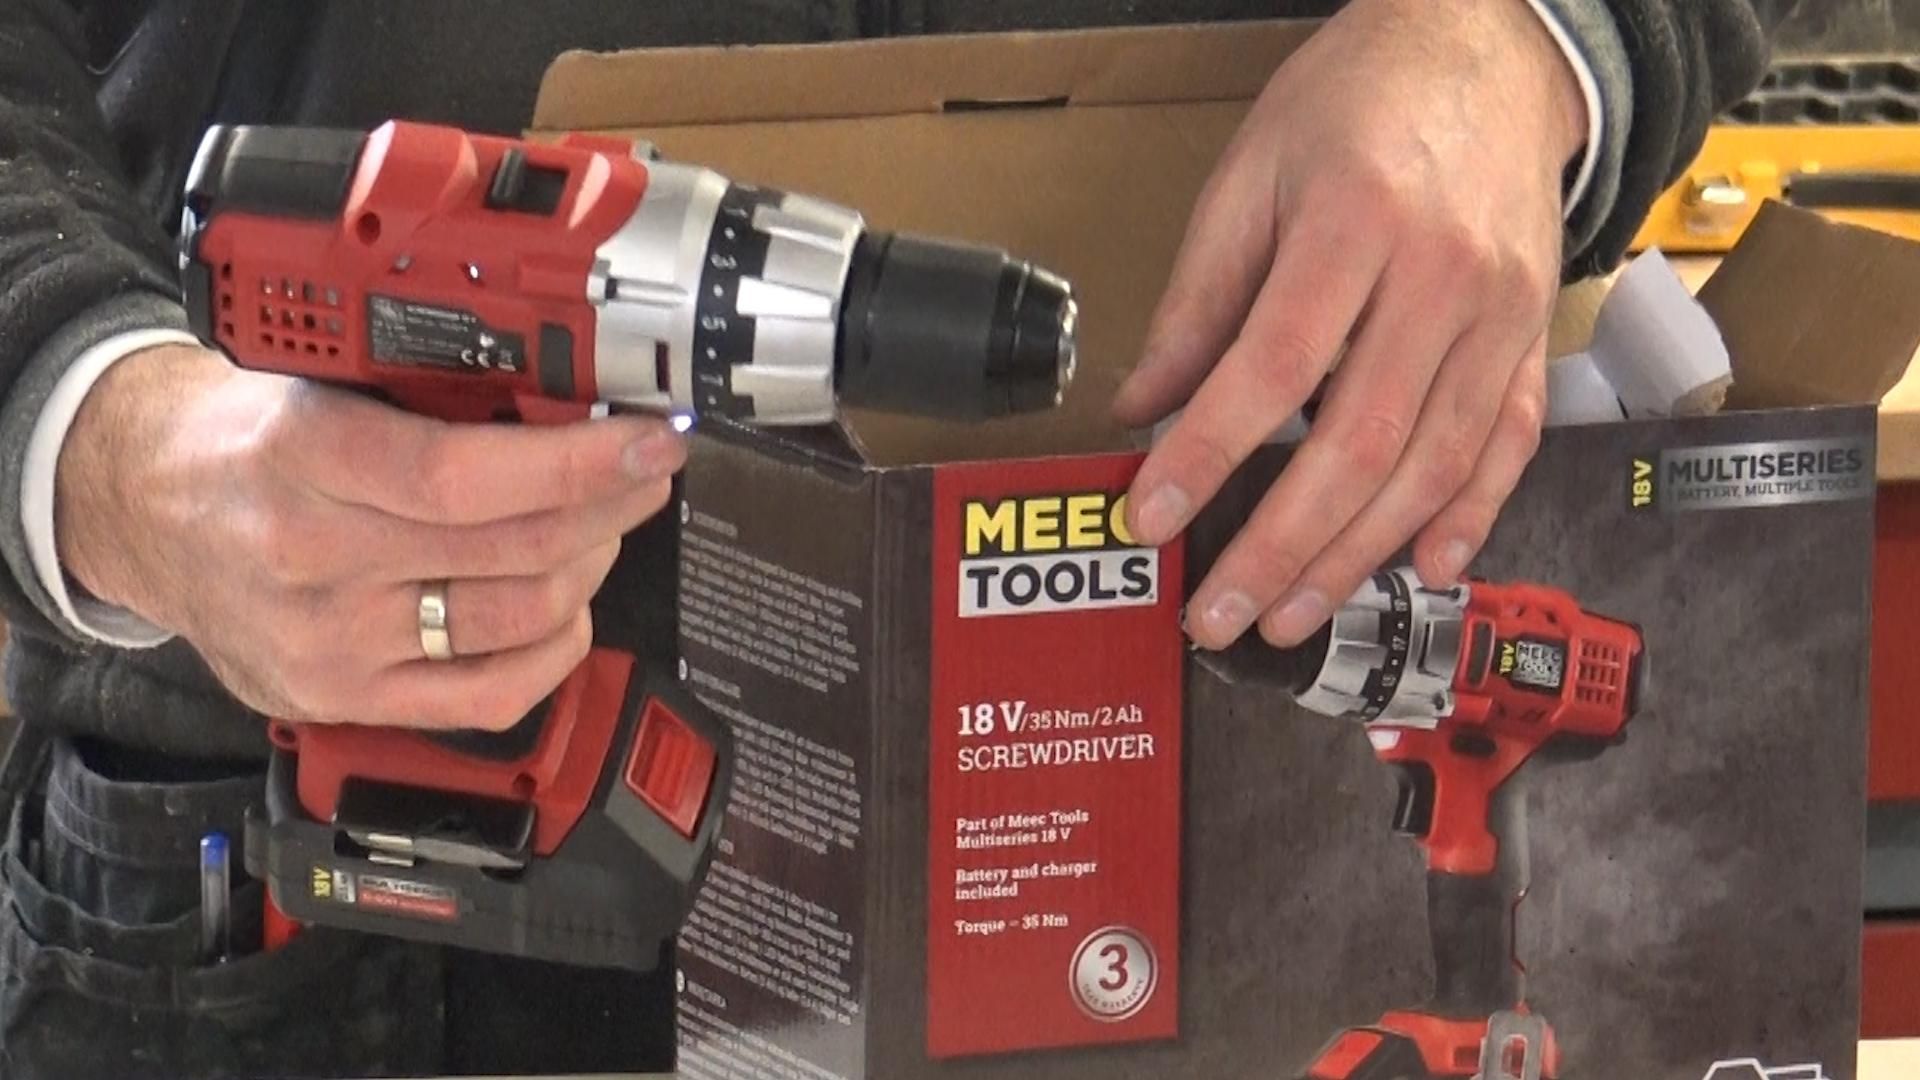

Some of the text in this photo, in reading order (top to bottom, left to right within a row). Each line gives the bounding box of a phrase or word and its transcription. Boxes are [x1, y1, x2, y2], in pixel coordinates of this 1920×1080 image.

[1668, 449, 1862, 484] MULTISERIES
[1632, 459, 1652, 507] 18V
[1744, 481, 1813, 497] MULTIPLE
[966, 556, 1152, 609] TOOLS
[957, 703, 995, 735] 18
[957, 733, 1155, 772] SCREWDRIVER
[956, 809, 1089, 833] Part of Meec Tools
[956, 827, 1072, 849] Multiseries 18 V
[955, 862, 1097, 883] Battery and charger
[955, 881, 1018, 900] included
[954, 918, 1006, 936] Torque
[1042, 913, 1069, 927] Nm
[1098, 943, 1128, 991] 3
